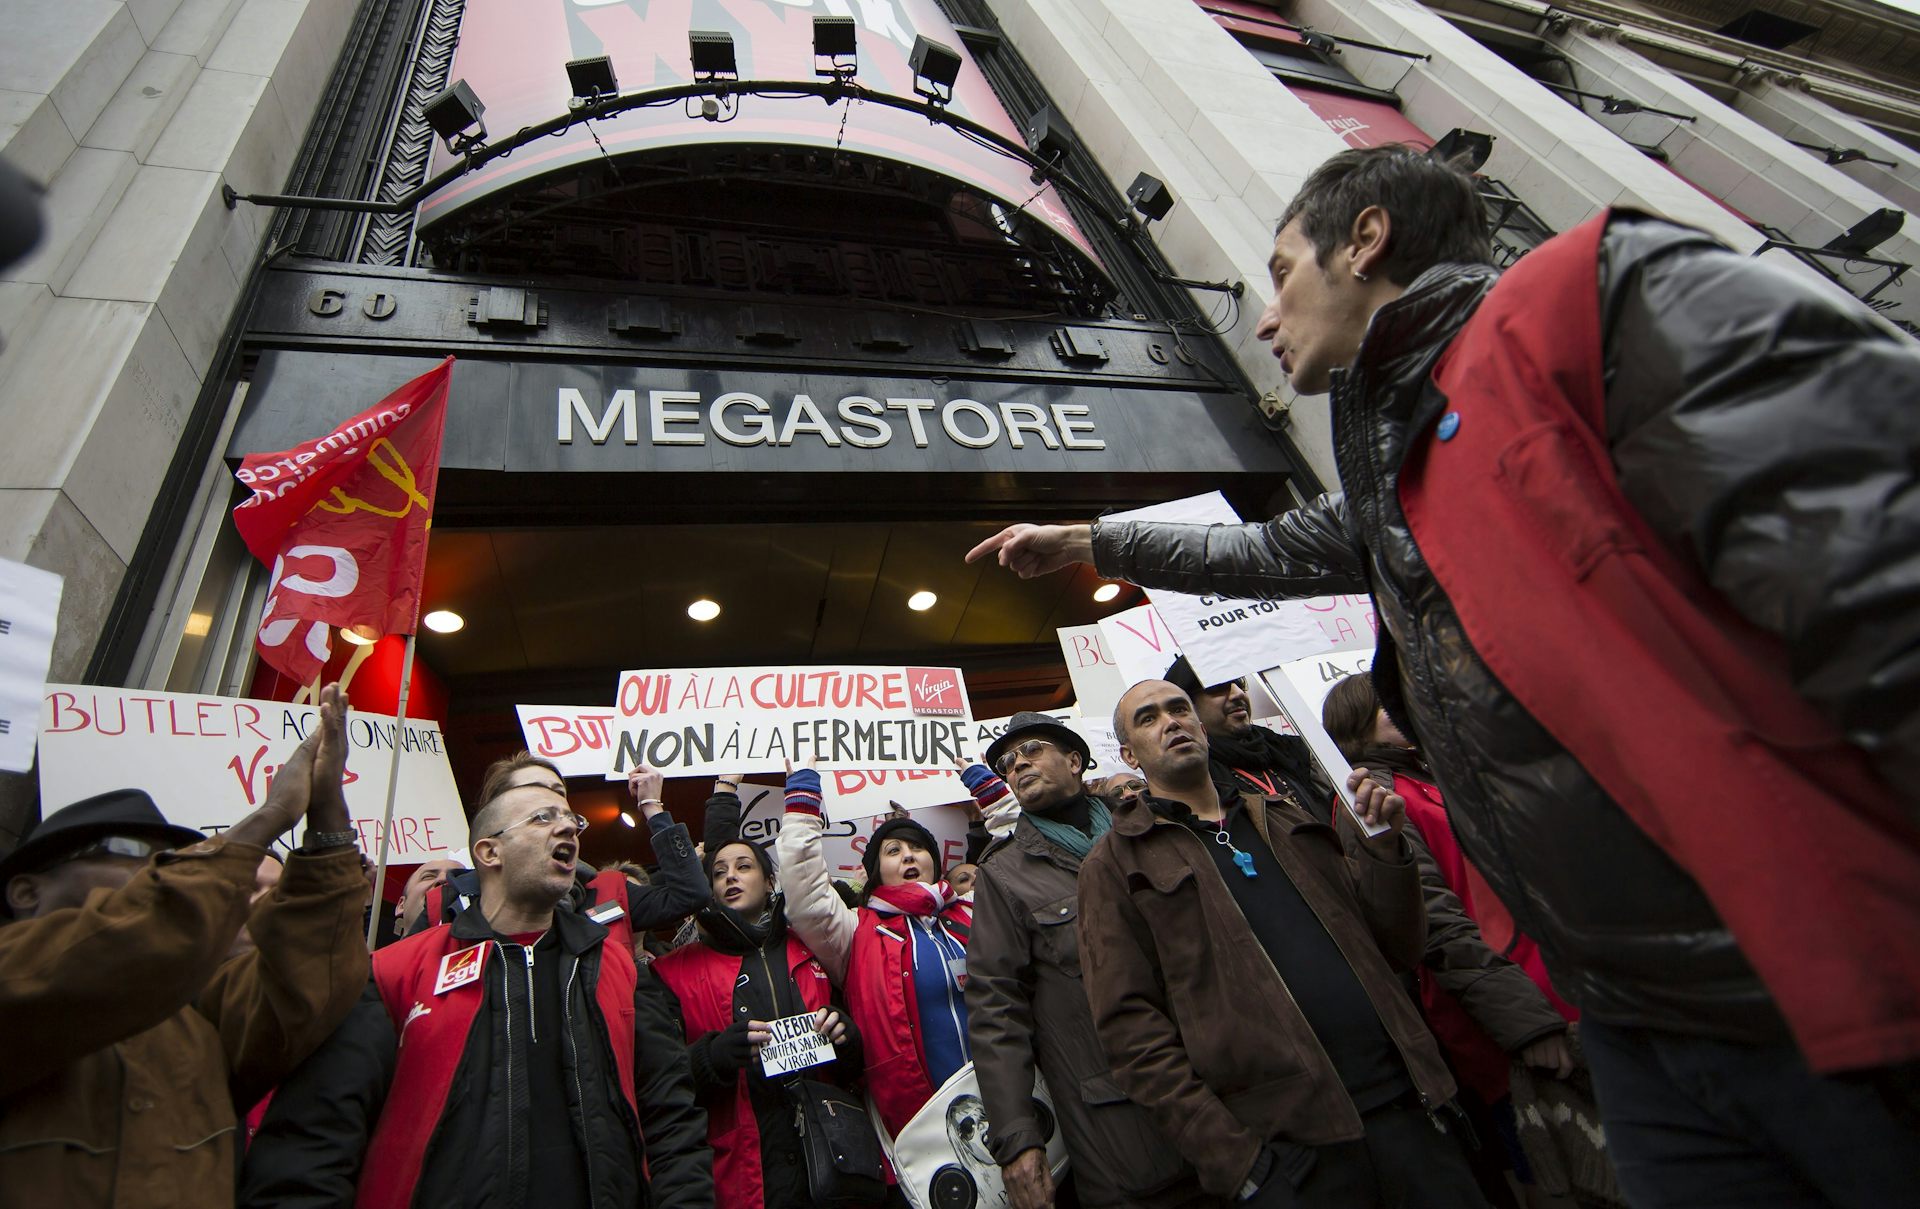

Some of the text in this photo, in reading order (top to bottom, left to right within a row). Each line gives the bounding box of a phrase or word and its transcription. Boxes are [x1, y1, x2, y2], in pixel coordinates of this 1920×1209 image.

[309, 287, 397, 318] 60
[558, 387, 1106, 449] MEGASTORE
[1198, 608, 1249, 631] POUR
[678, 672, 700, 710] À
[703, 674, 744, 710] LA
[750, 671, 907, 711] CULTURE
[914, 673, 955, 704] Virgin
[45, 691, 443, 756] BUTLER ACONNAIRE
[913, 707, 964, 715] MEGASTORE
[613, 723, 715, 773] NON
[720, 720, 740, 760] À
[747, 726, 786, 759] LA
[793, 719, 973, 765] FERMETURE
[443, 961, 478, 983] cgt
[761, 1041, 798, 1063] SOUTIEN
[776, 1051, 818, 1071] VIRGIN
